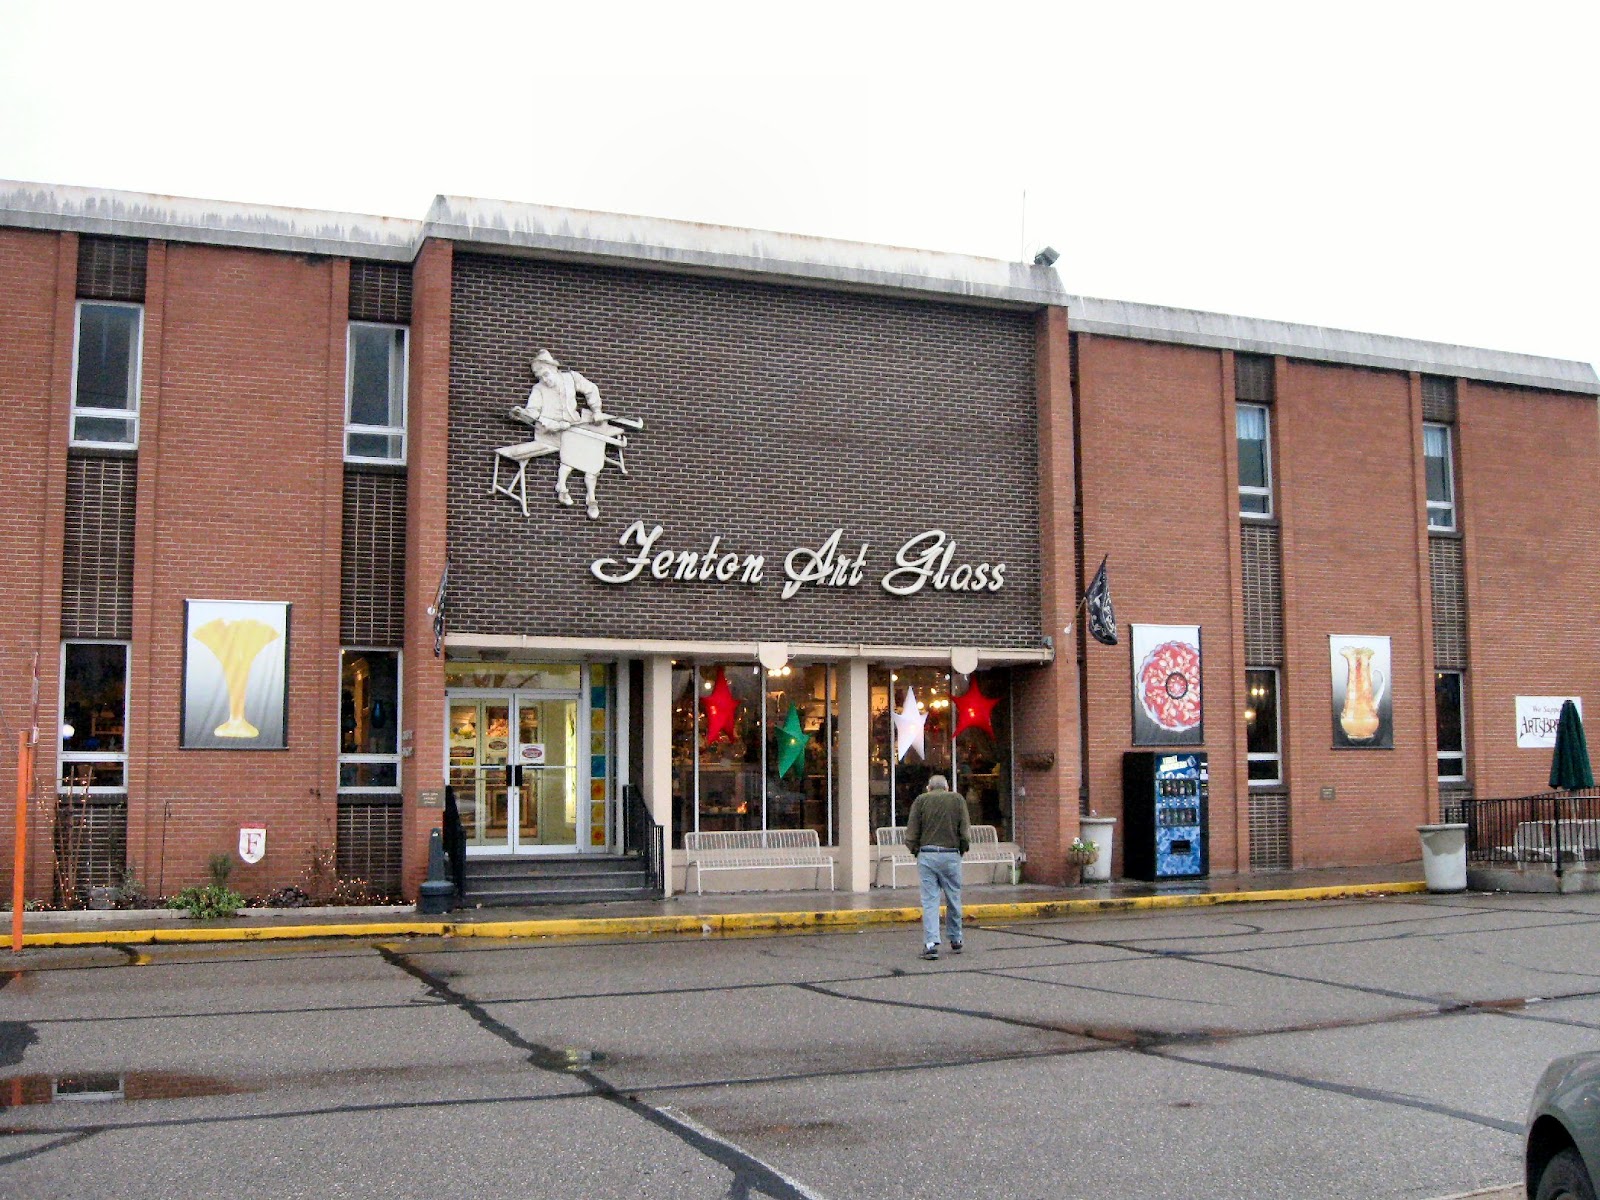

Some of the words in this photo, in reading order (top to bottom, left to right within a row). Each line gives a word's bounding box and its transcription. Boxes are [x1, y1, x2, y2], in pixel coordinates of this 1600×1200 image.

[590, 520, 765, 584] Fenton
[781, 527, 869, 600] Art
[881, 529, 1006, 595] Glass
[246, 833, 261, 854] F
